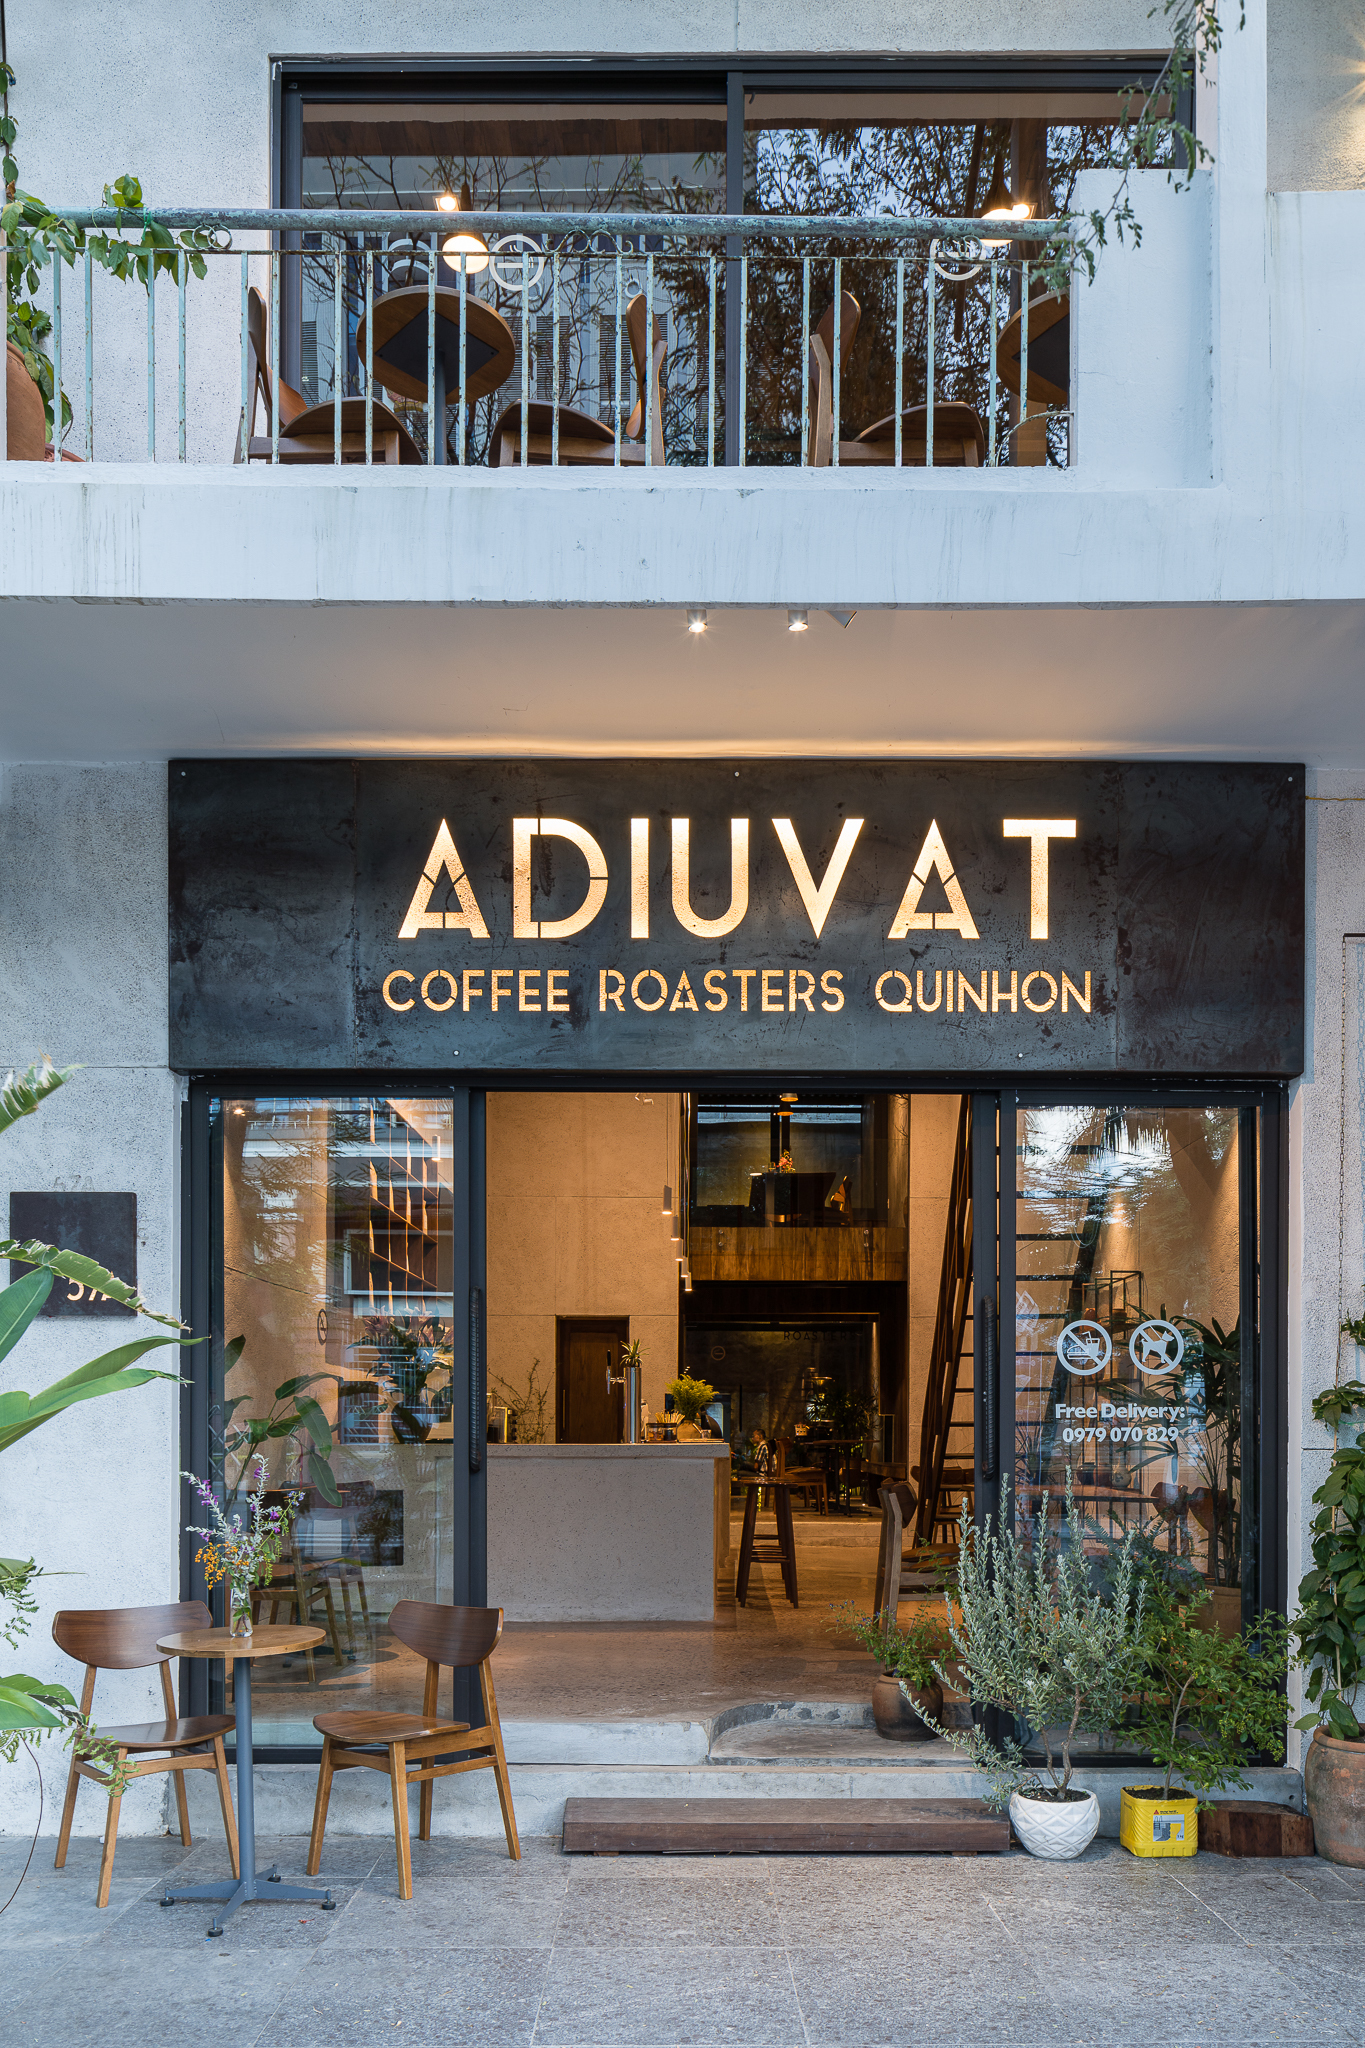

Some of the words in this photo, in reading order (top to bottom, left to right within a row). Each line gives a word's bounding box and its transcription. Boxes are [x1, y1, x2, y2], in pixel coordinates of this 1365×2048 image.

[397, 817, 1078, 941] ADIUVAT
[382, 969, 571, 1012] COFFEE
[598, 969, 845, 1013] ROASTERS
[874, 970, 1092, 1014] QUINHON
[783, 1330, 857, 1341] ROASTERS
[1055, 1403, 1097, 1419] Free
[1101, 1403, 1186, 1423] Delivery:
[1062, 1427, 1107, 1443] 0979
[1110, 1427, 1143, 1443] 070
[1146, 1426, 1179, 1442] 829
